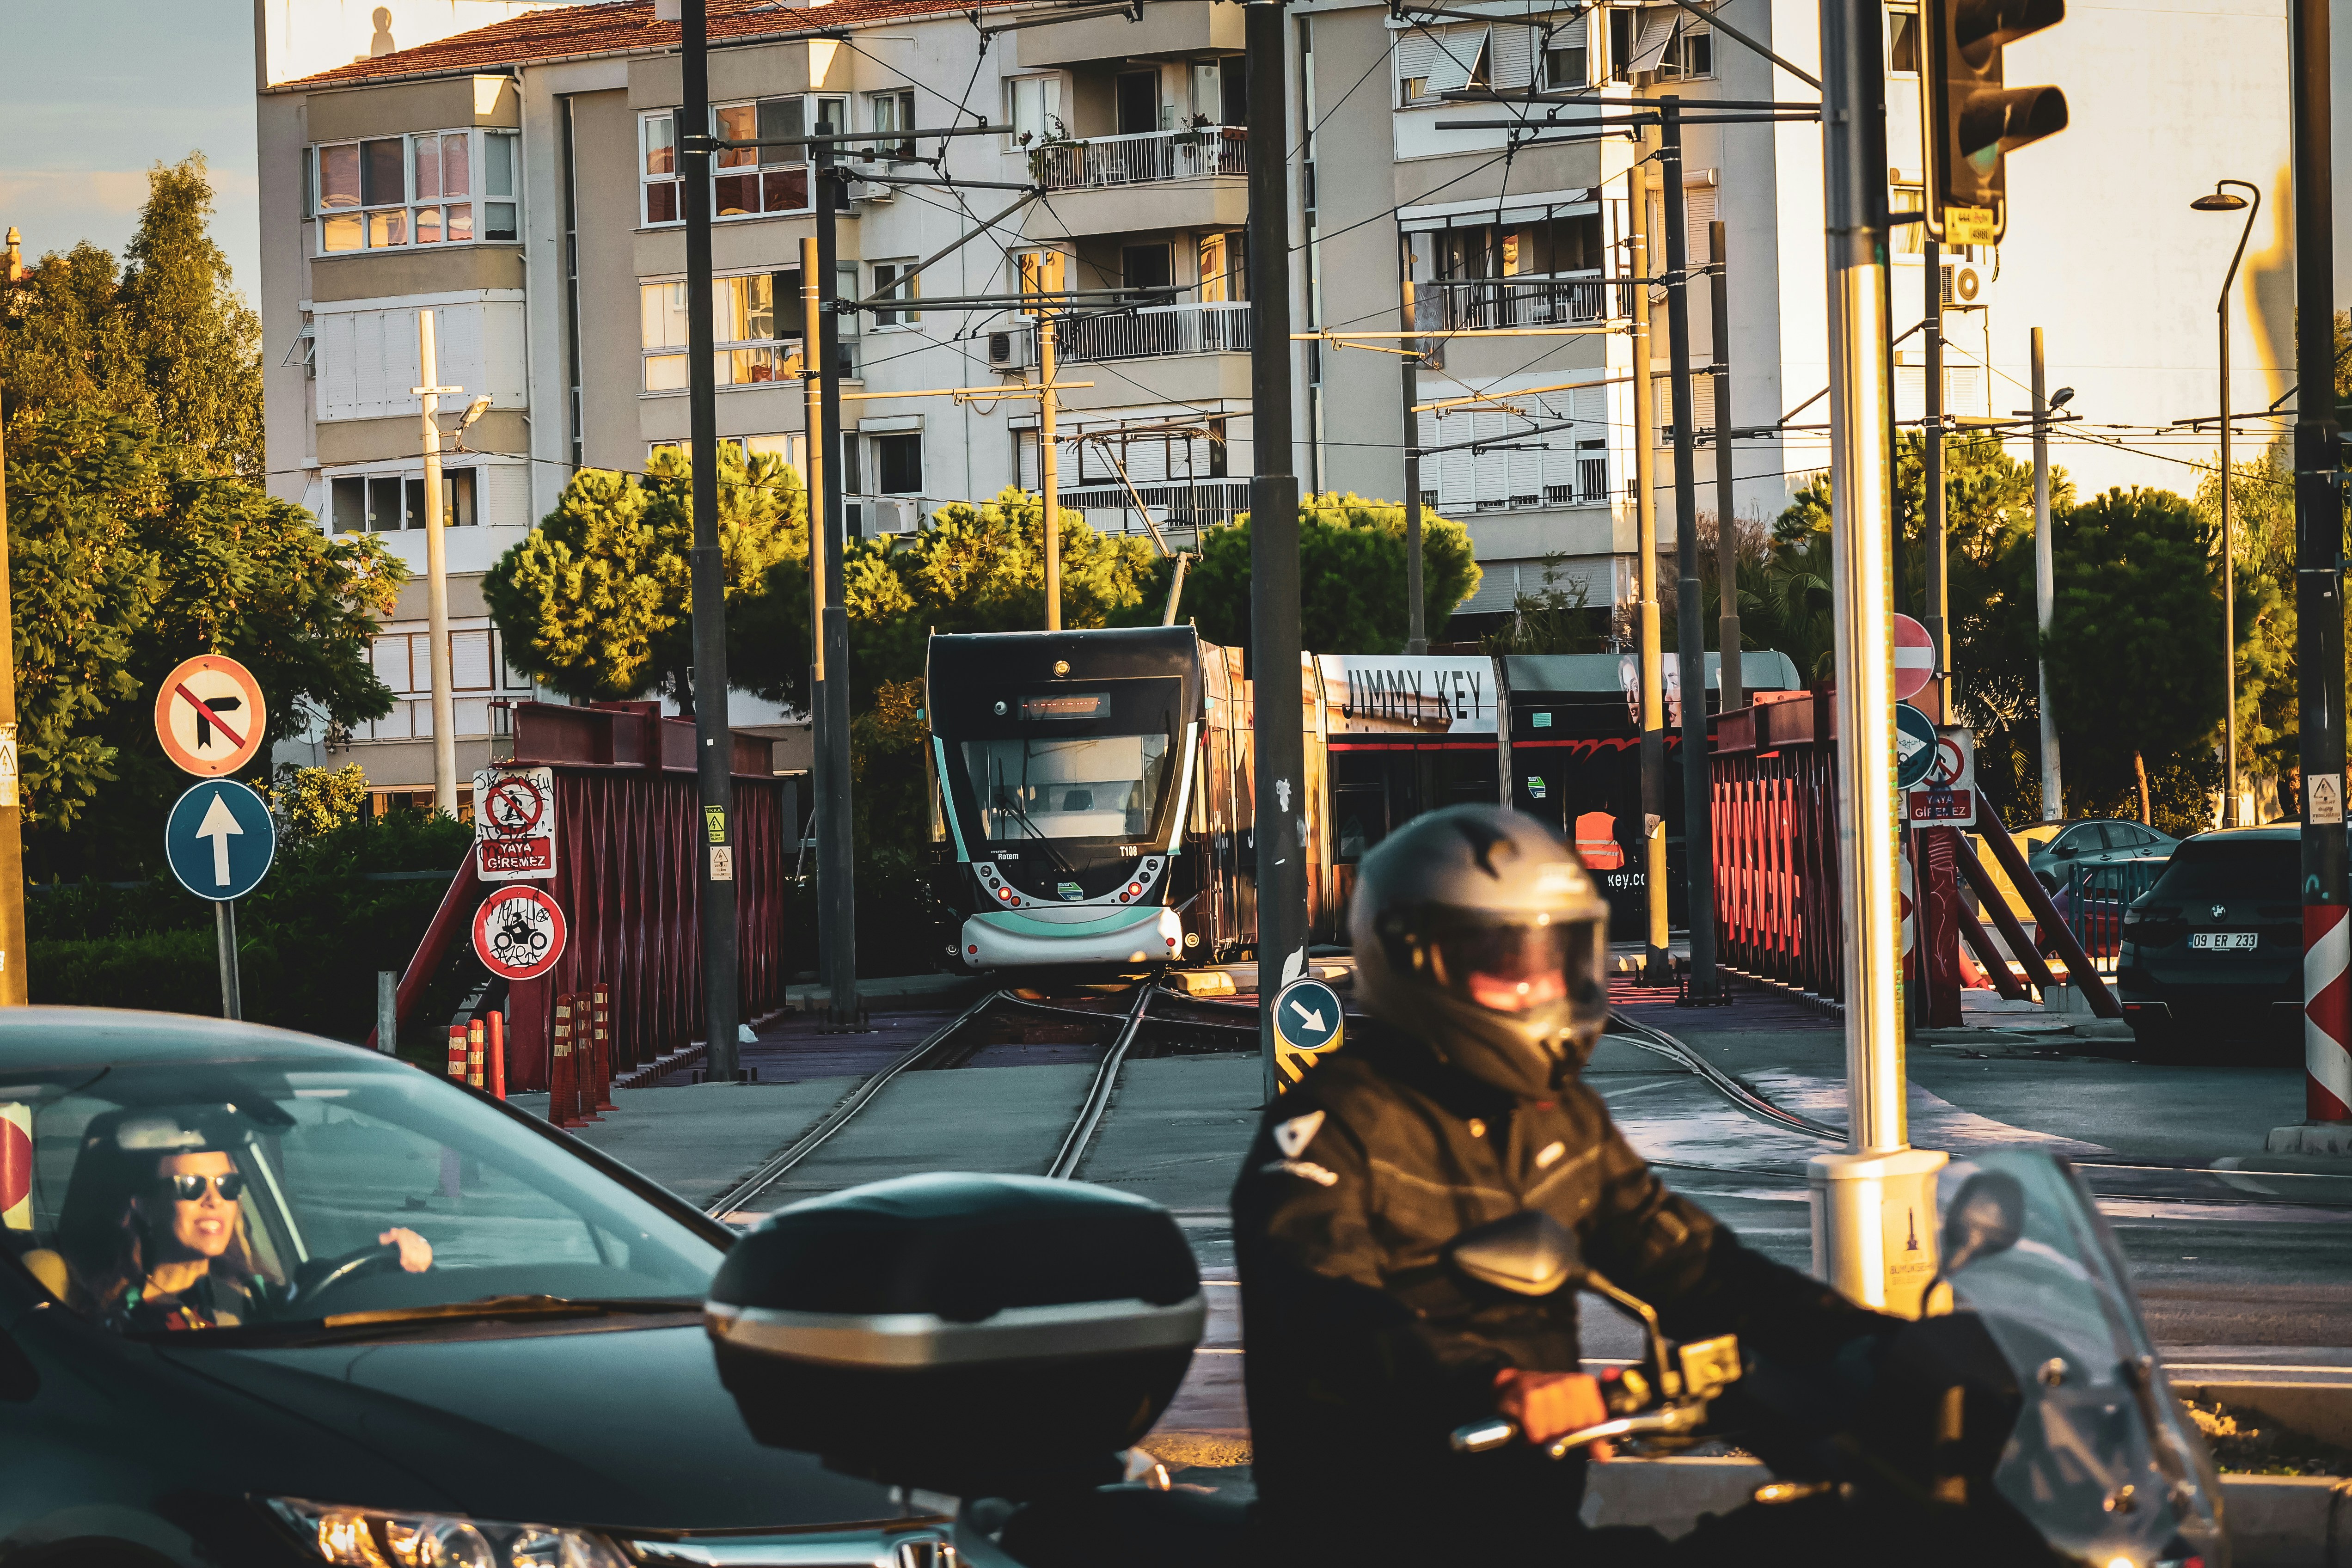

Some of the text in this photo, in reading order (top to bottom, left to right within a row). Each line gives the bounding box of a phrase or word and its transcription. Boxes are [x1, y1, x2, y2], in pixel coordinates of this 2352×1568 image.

[1342, 670, 1480, 719] JIMMY KEY
[500, 844, 532, 853] YAYA
[1120, 846, 1137, 857] T108
[488, 856, 546, 869] GİREMEZ
[2194, 935, 2255, 947] 09 ER 233
